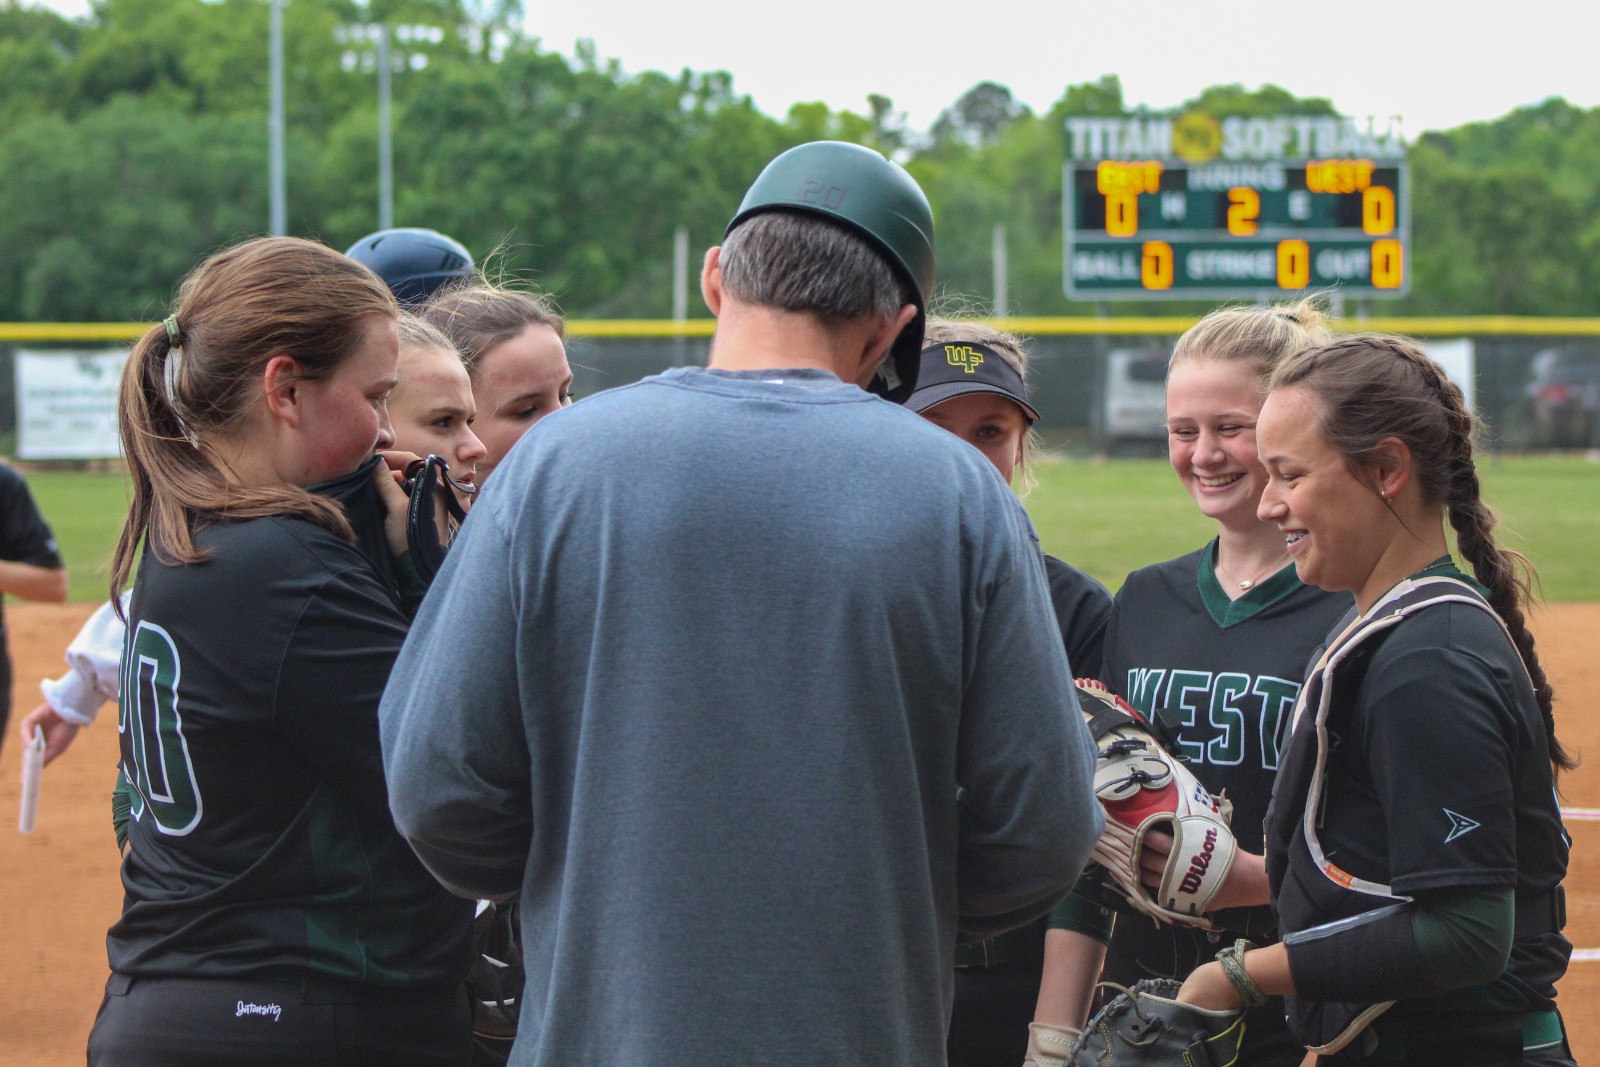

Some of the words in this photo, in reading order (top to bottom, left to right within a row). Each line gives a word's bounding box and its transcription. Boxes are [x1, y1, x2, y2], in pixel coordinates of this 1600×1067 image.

[1066, 117, 1171, 159] TITAN
[1222, 116, 1404, 159] SOFTBALL
[797, 179, 845, 210] 20
[1106, 194, 1138, 237] 0
[1227, 187, 1260, 236] 2
[1362, 186, 1395, 235] 0
[1073, 252, 1139, 280] BALL
[1186, 251, 1276, 280] STRIKE
[1277, 240, 1309, 289] 0
[1316, 251, 1370, 280] OUT
[1371, 239, 1402, 289] 0
[1127, 668, 1302, 770] WEST
[1177, 828, 1218, 895] Wilson
[235, 1000, 282, 1022] Intensity
